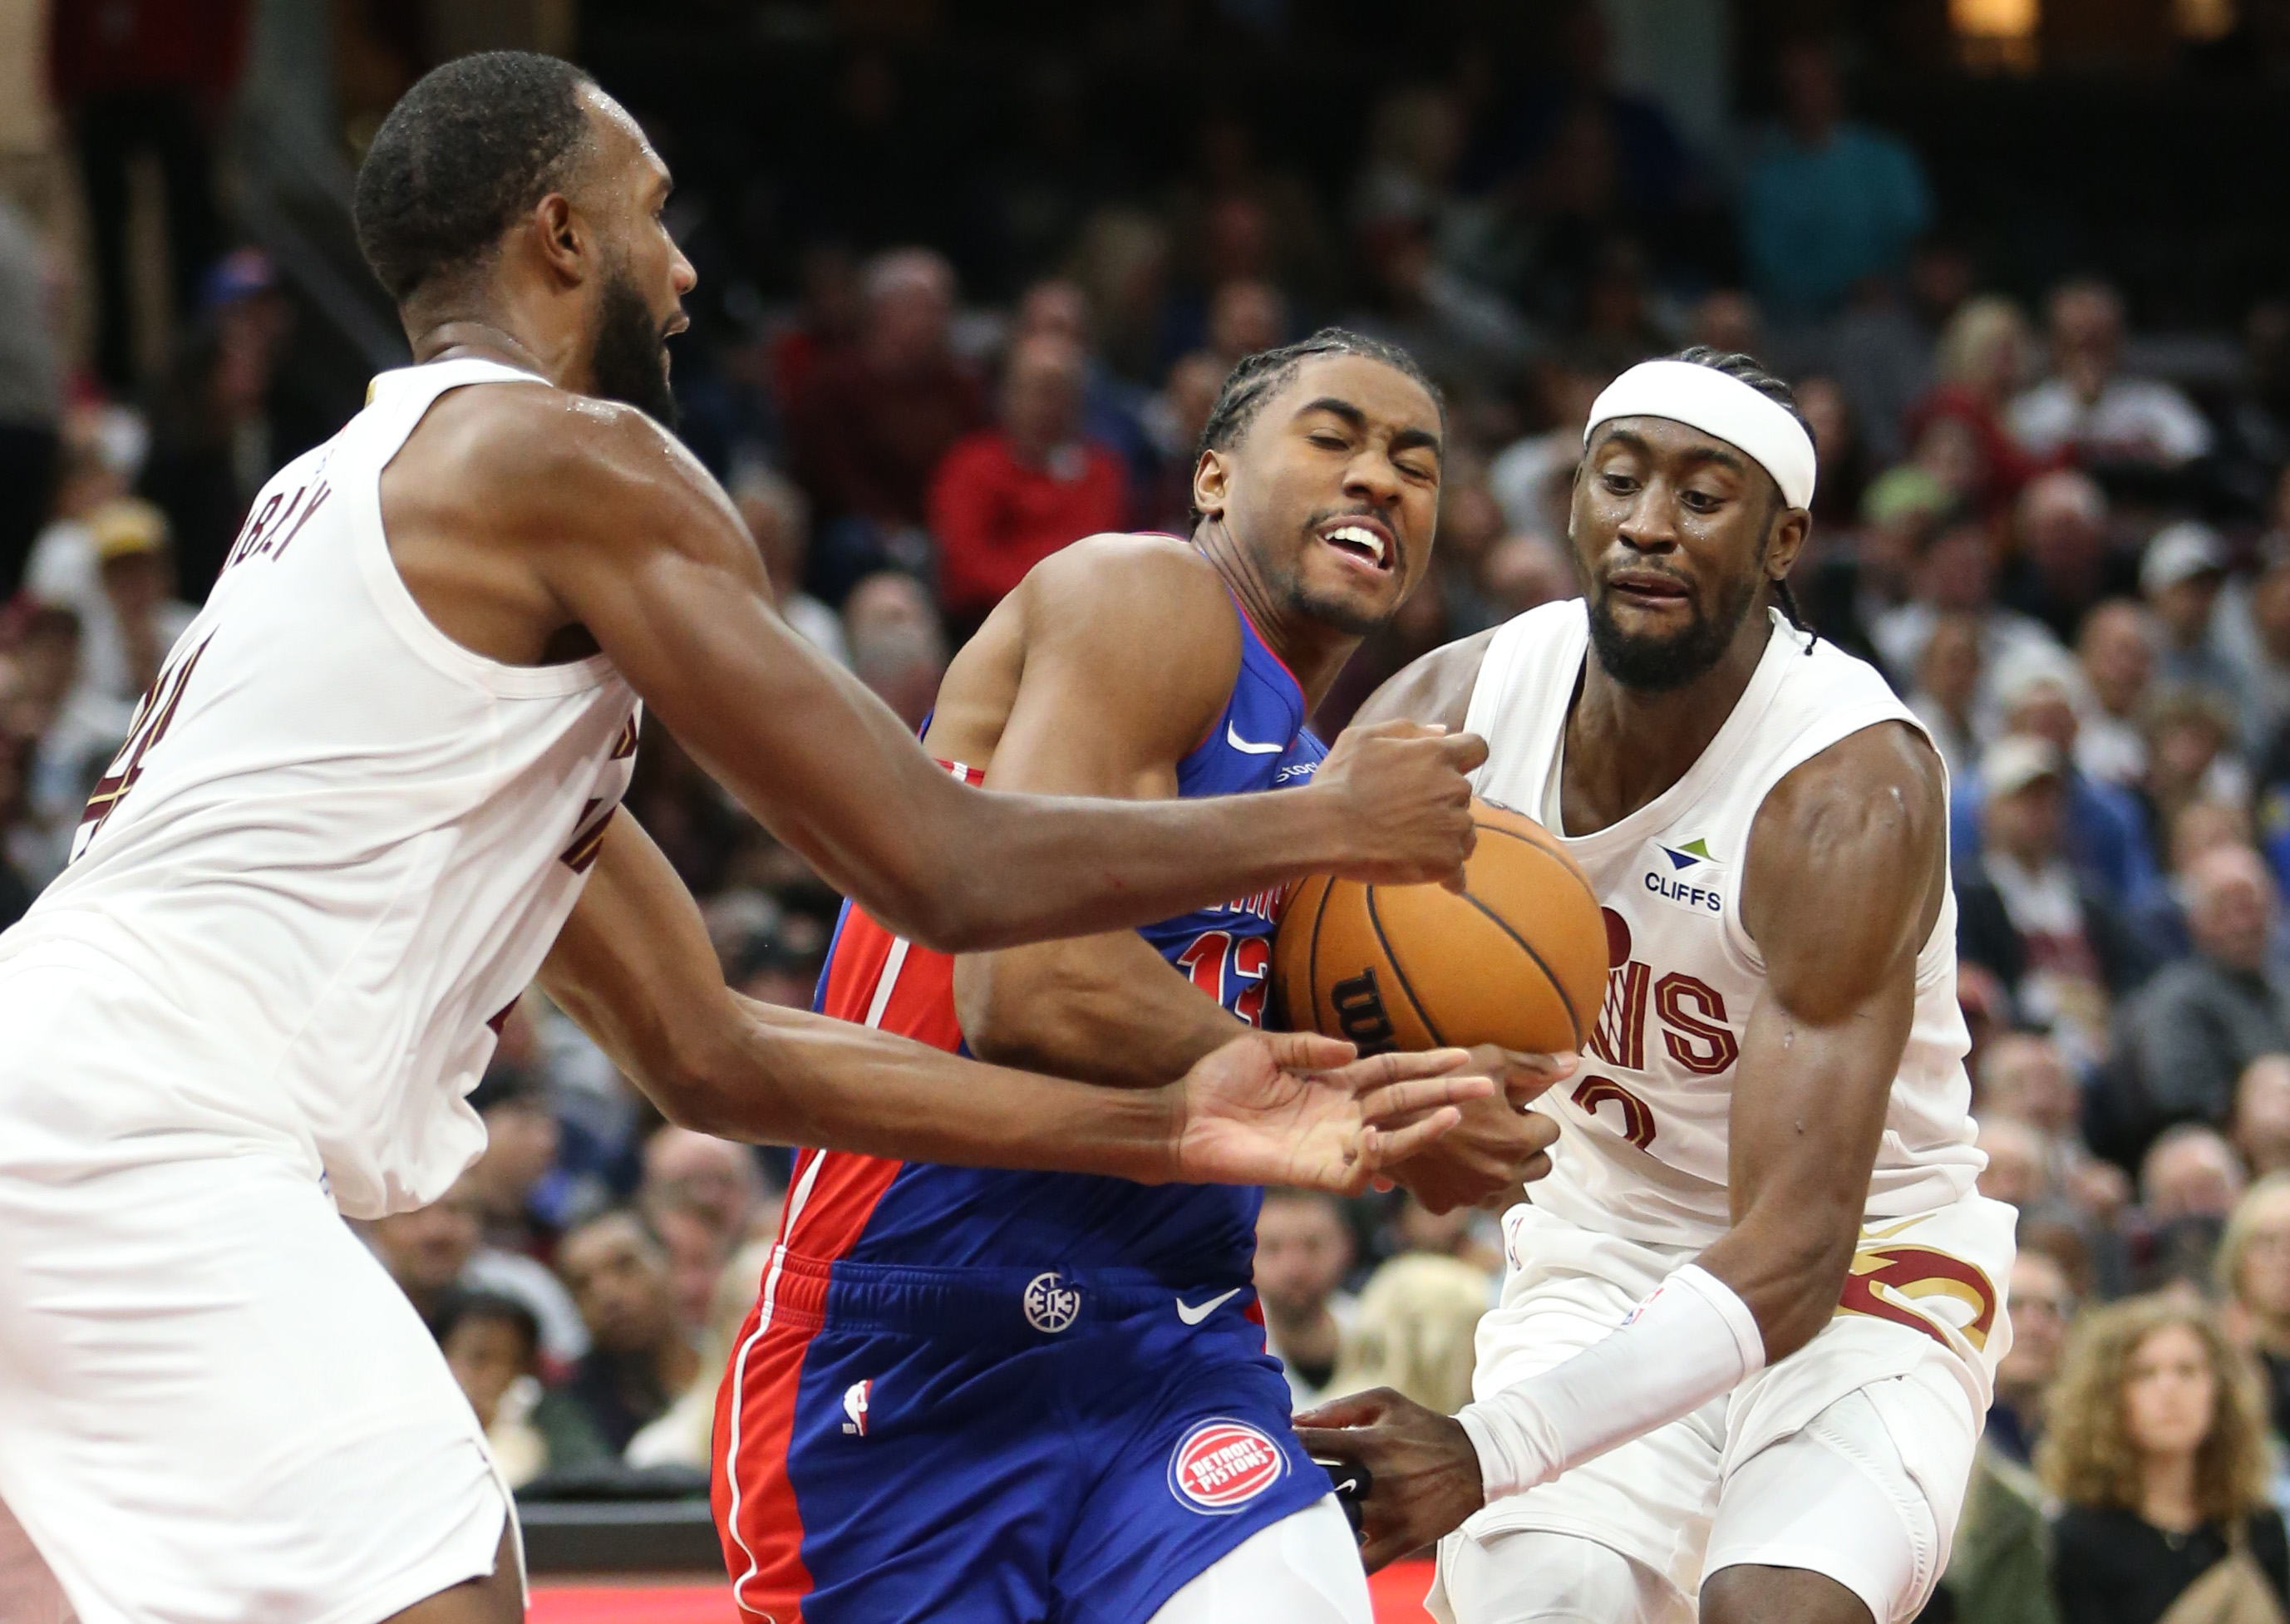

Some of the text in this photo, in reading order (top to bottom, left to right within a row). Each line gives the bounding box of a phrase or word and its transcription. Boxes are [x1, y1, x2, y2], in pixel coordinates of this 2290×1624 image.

[1645, 872, 1721, 912] CLIFFS
[1189, 1438, 1258, 1478] DETROIT
[1197, 1450, 1268, 1492] PISTONS
